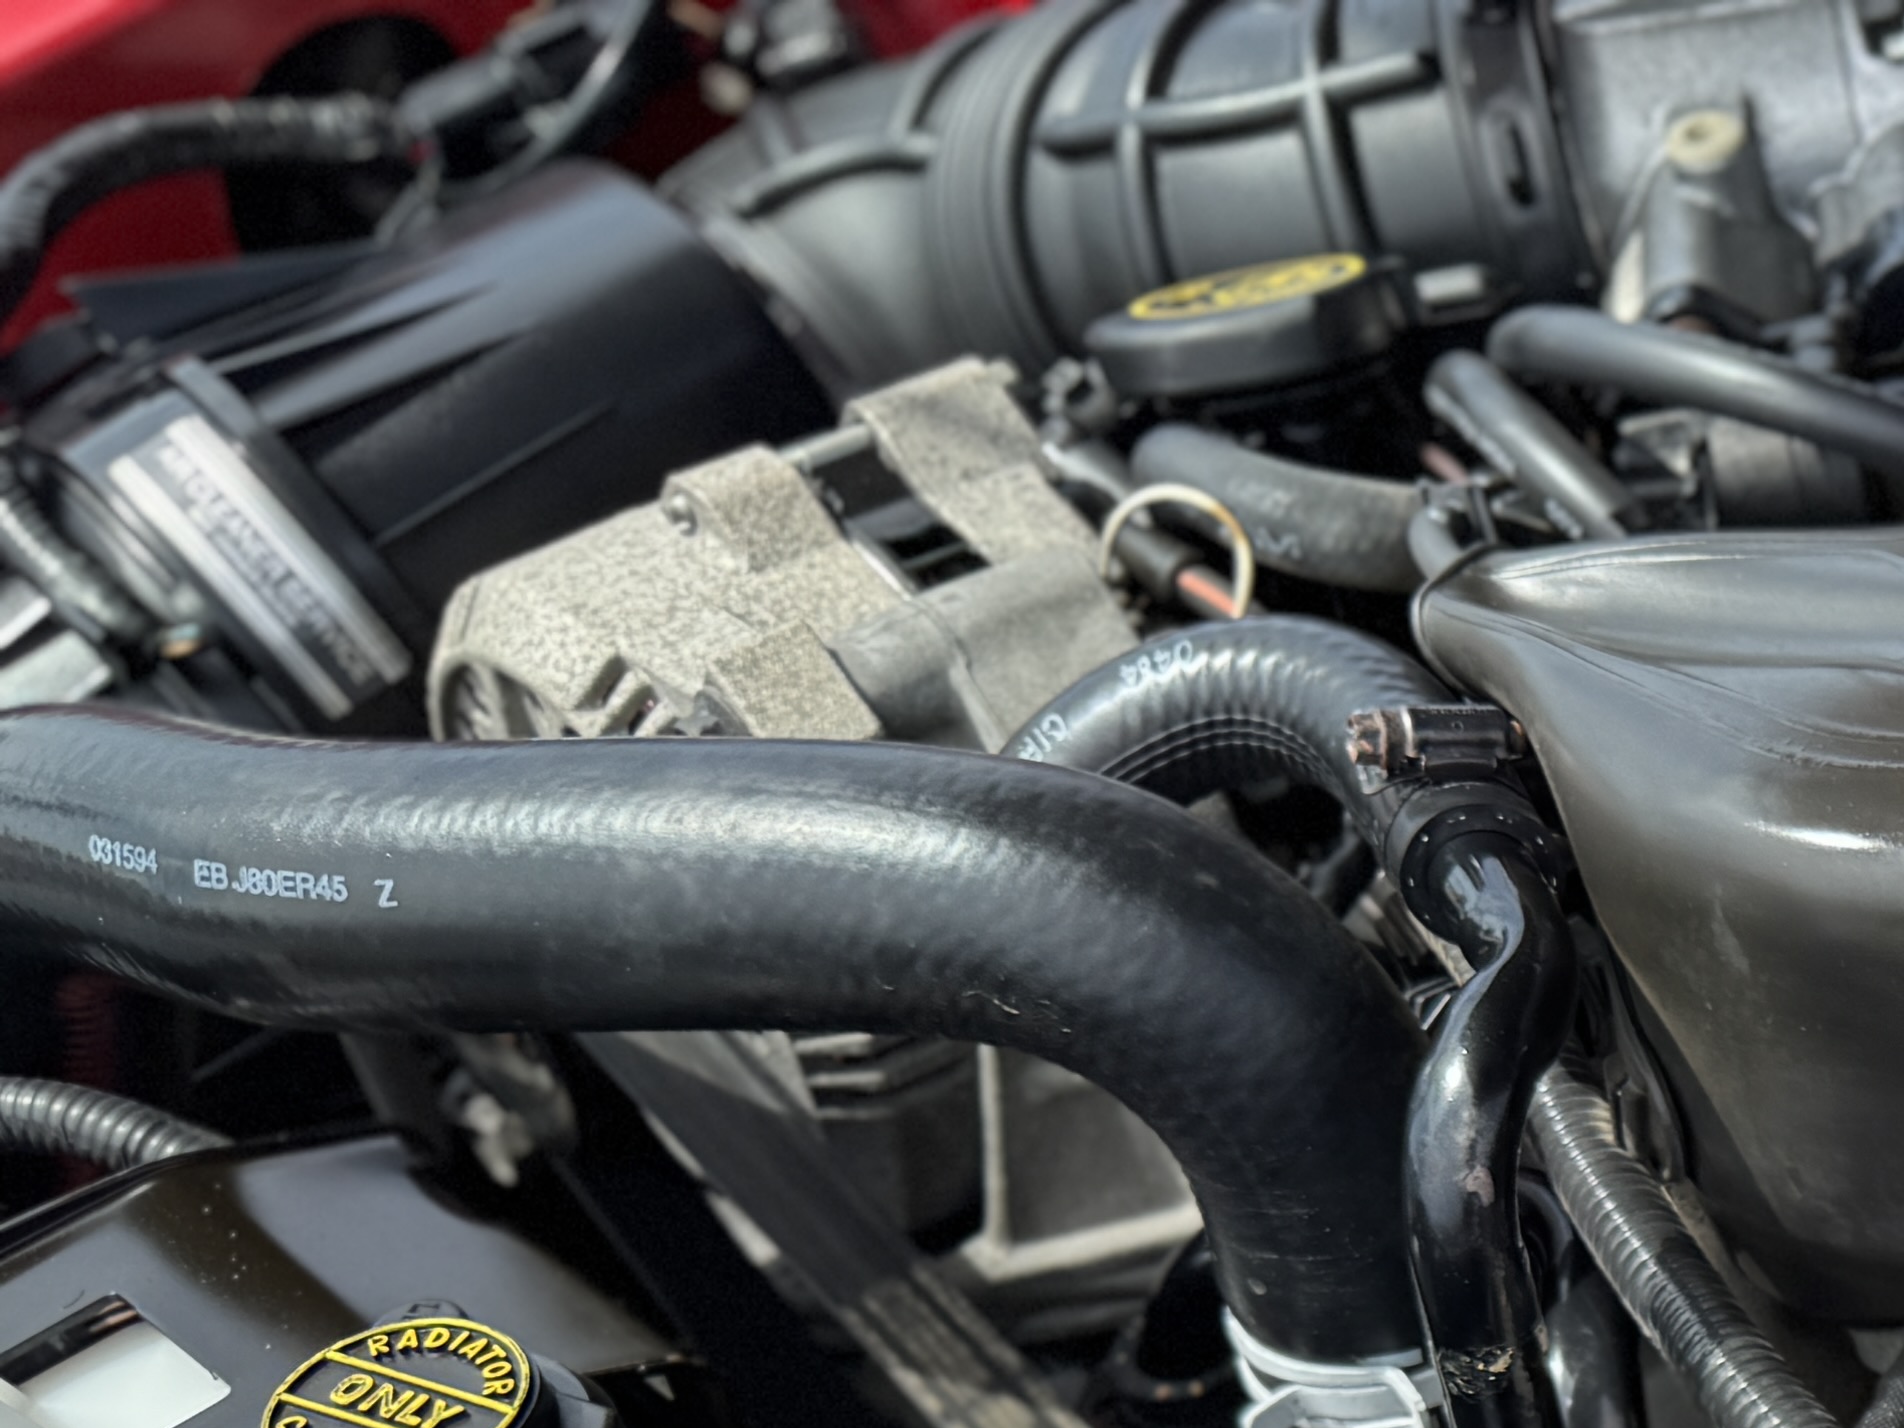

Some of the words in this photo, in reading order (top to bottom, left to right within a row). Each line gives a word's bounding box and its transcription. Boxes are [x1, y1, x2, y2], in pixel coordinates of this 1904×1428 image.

[88, 834, 158, 875] 031594
[374, 879, 399, 908] Z
[366, 1326, 516, 1397] RADIATOR
